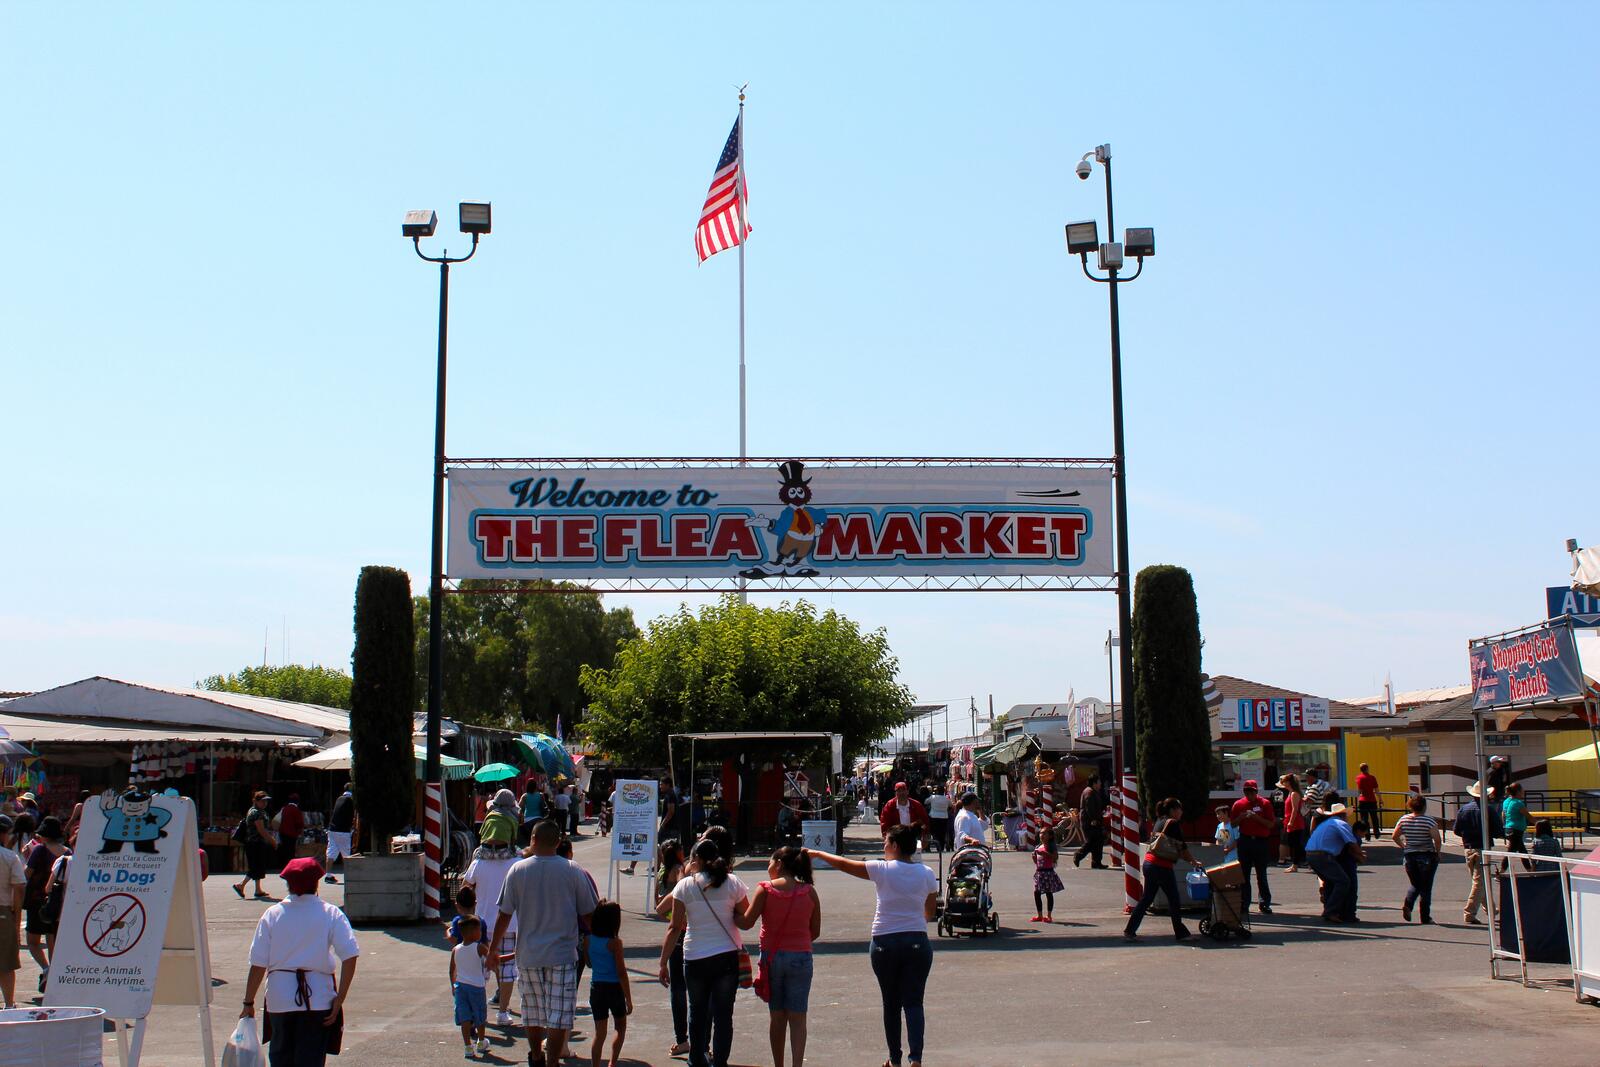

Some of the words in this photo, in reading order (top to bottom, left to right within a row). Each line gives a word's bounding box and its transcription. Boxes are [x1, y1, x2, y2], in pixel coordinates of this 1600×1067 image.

[509, 477, 671, 508] Welcome
[676, 484, 719, 507] to
[475, 513, 598, 562] THE
[603, 513, 763, 562] FLEA
[813, 511, 1087, 560] MARKET
[1491, 637, 1535, 673] Shopping
[1534, 630, 1559, 663] Cart
[1508, 667, 1548, 701] Rentals
[1242, 701, 1301, 729] ICEE
[142, 855, 168, 863] County
[87, 869, 111, 883] No
[116, 869, 156, 886] Dogs
[58, 976, 101, 985] Welcome
[65, 965, 100, 974] Service
[102, 965, 142, 975] Animals
